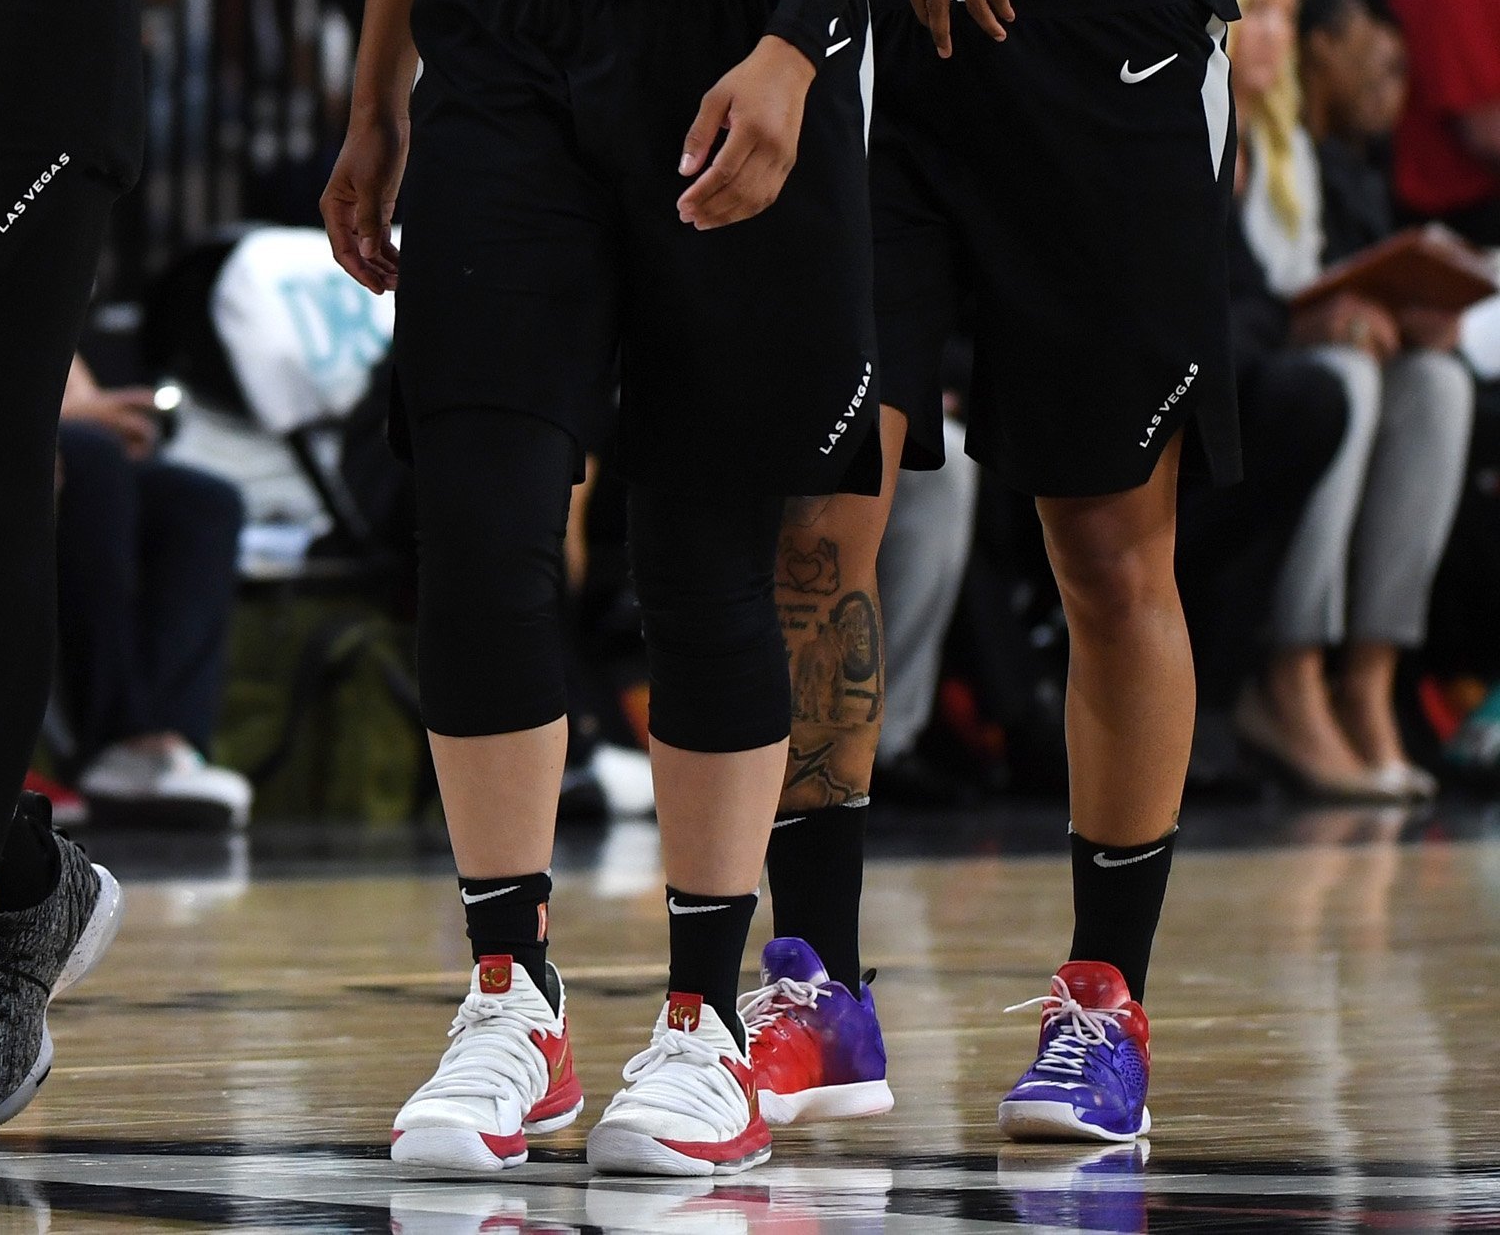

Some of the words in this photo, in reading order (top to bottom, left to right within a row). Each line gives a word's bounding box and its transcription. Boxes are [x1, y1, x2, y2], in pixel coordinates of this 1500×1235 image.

[23, 152, 70, 201] VEGAS
[820, 421, 847, 455] LAS
[844, 361, 872, 418] VEGAS
[1139, 415, 1161, 448] LAS
[1159, 362, 1199, 412] VEGAS
